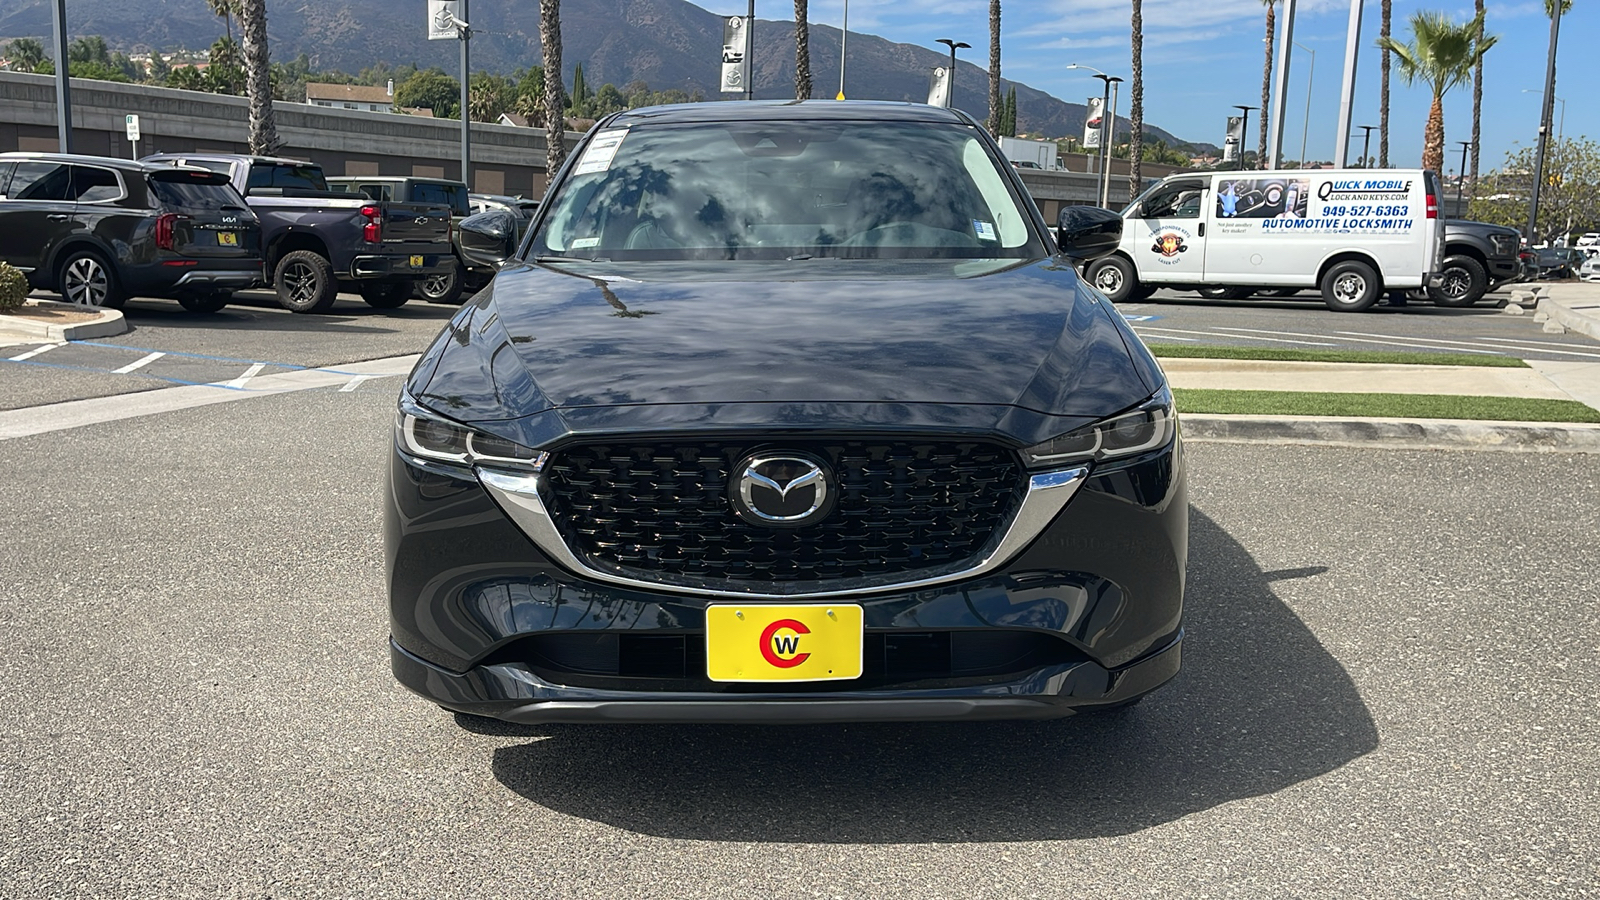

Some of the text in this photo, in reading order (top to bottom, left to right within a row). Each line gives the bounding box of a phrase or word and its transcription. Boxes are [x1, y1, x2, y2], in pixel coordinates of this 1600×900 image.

[1318, 181, 1412, 201] QUICK MOBILE
[1322, 205, 1409, 217] 949-527-6363
[1262, 219, 1413, 229] AUTOMOTIVE LOCKSMITH
